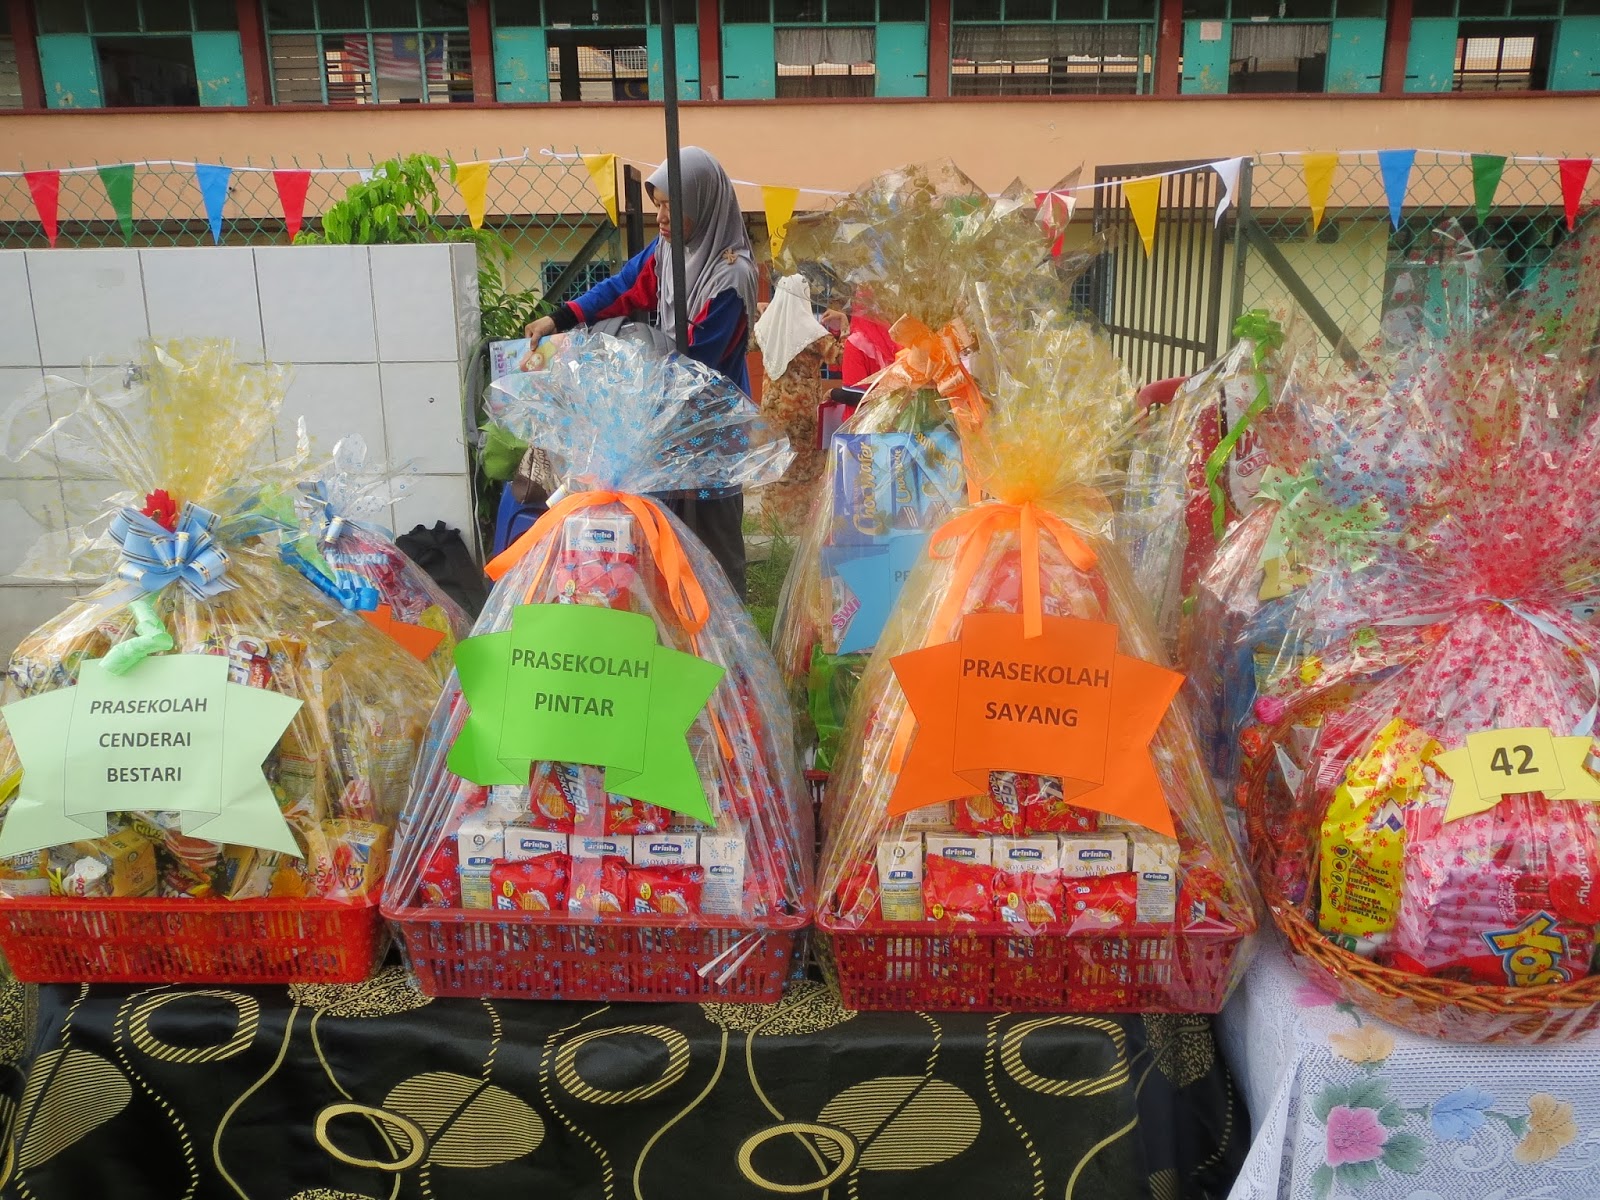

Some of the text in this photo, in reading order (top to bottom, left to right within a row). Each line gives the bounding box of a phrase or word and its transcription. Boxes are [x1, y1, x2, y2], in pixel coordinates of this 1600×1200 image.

[511, 648, 650, 679] PRASEKOLAH
[962, 658, 1110, 688] PRASEKOLAH
[90, 697, 208, 715] PRASEKOLAH
[534, 692, 615, 718] PINTAR
[984, 701, 1079, 728] SAYANG
[99, 731, 192, 749] CENDERAI
[1490, 744, 1540, 777] 42
[107, 766, 182, 783] BESTARI
[652, 844, 679, 852] drinho
[945, 848, 973, 856] drinho
[1011, 849, 1040, 857] drinho
[1081, 851, 1110, 859] drinho
[1145, 873, 1168, 881] drinho
